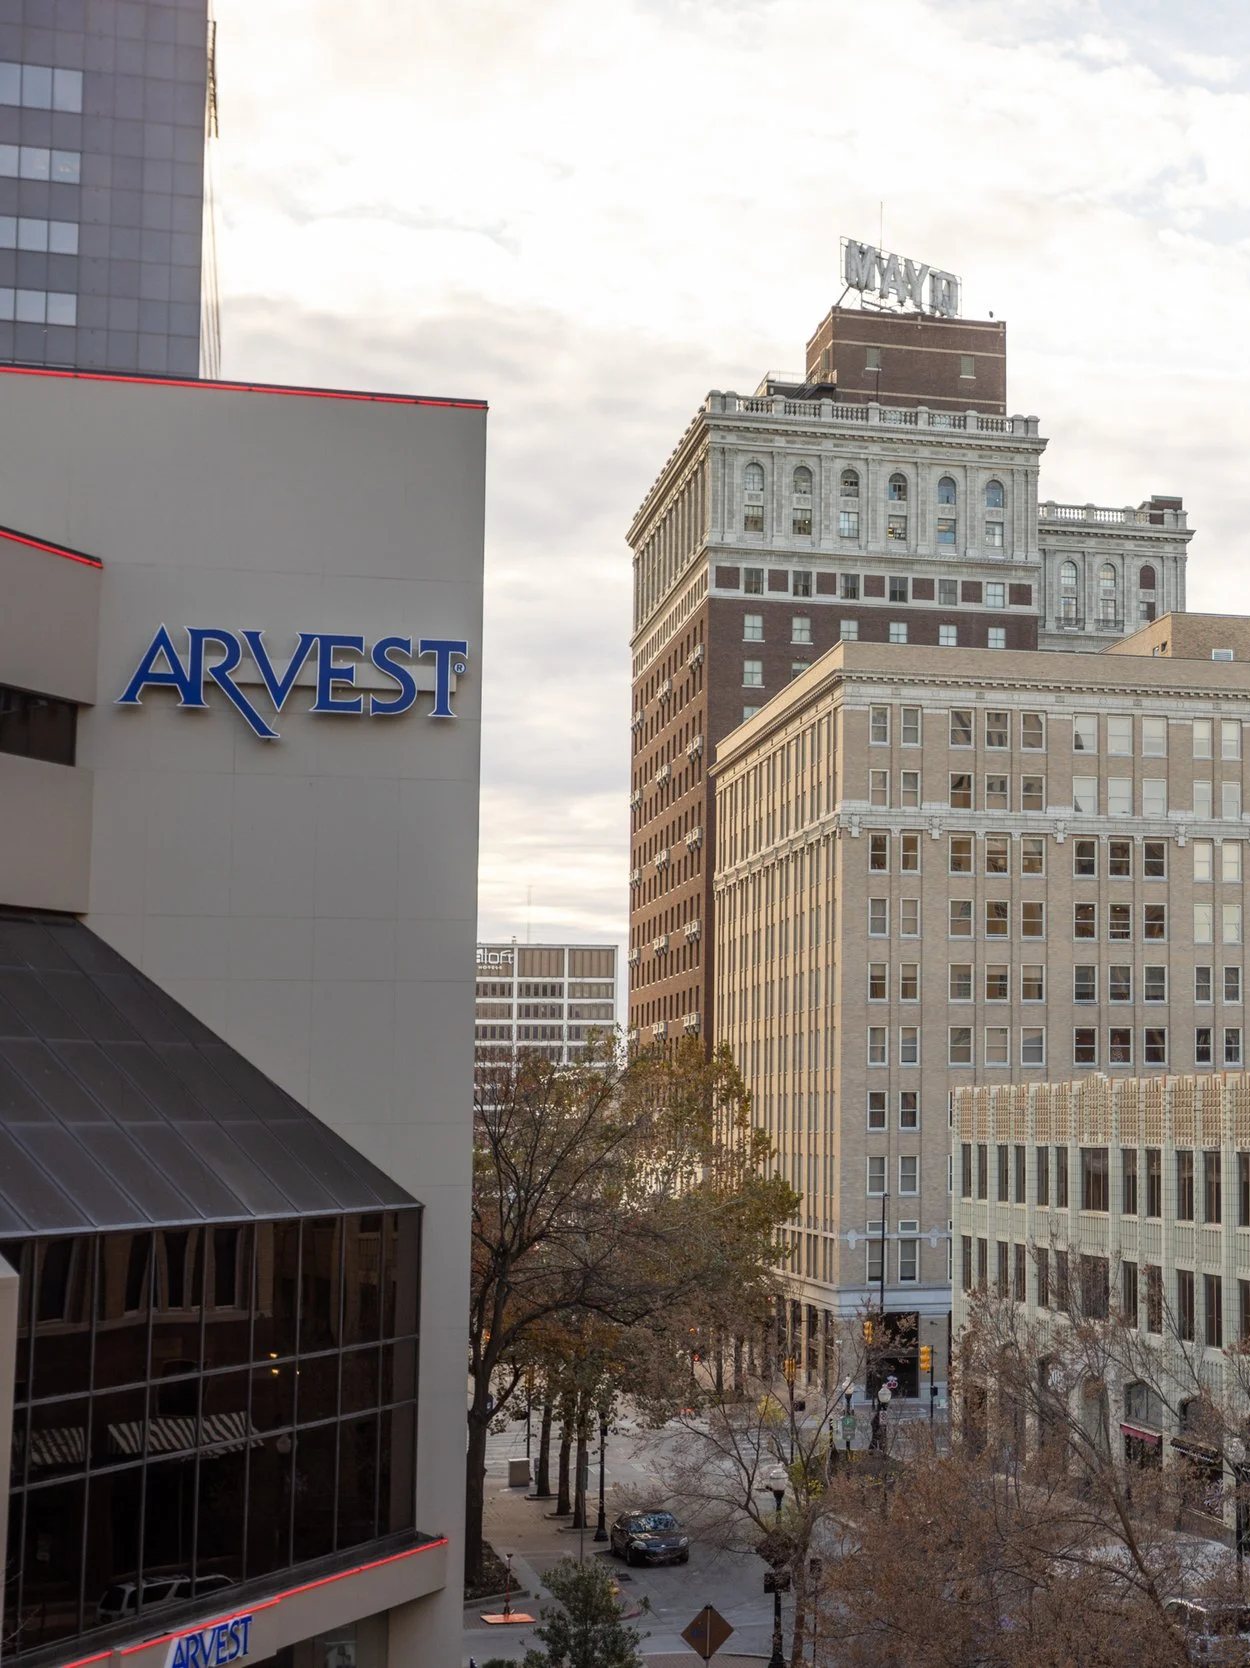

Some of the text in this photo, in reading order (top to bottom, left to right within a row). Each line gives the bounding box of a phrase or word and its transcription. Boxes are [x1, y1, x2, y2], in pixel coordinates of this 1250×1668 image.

[845, 239, 959, 317] MAYO
[114, 622, 468, 738] ARVEST
[172, 1615, 253, 1668] ARVEST
